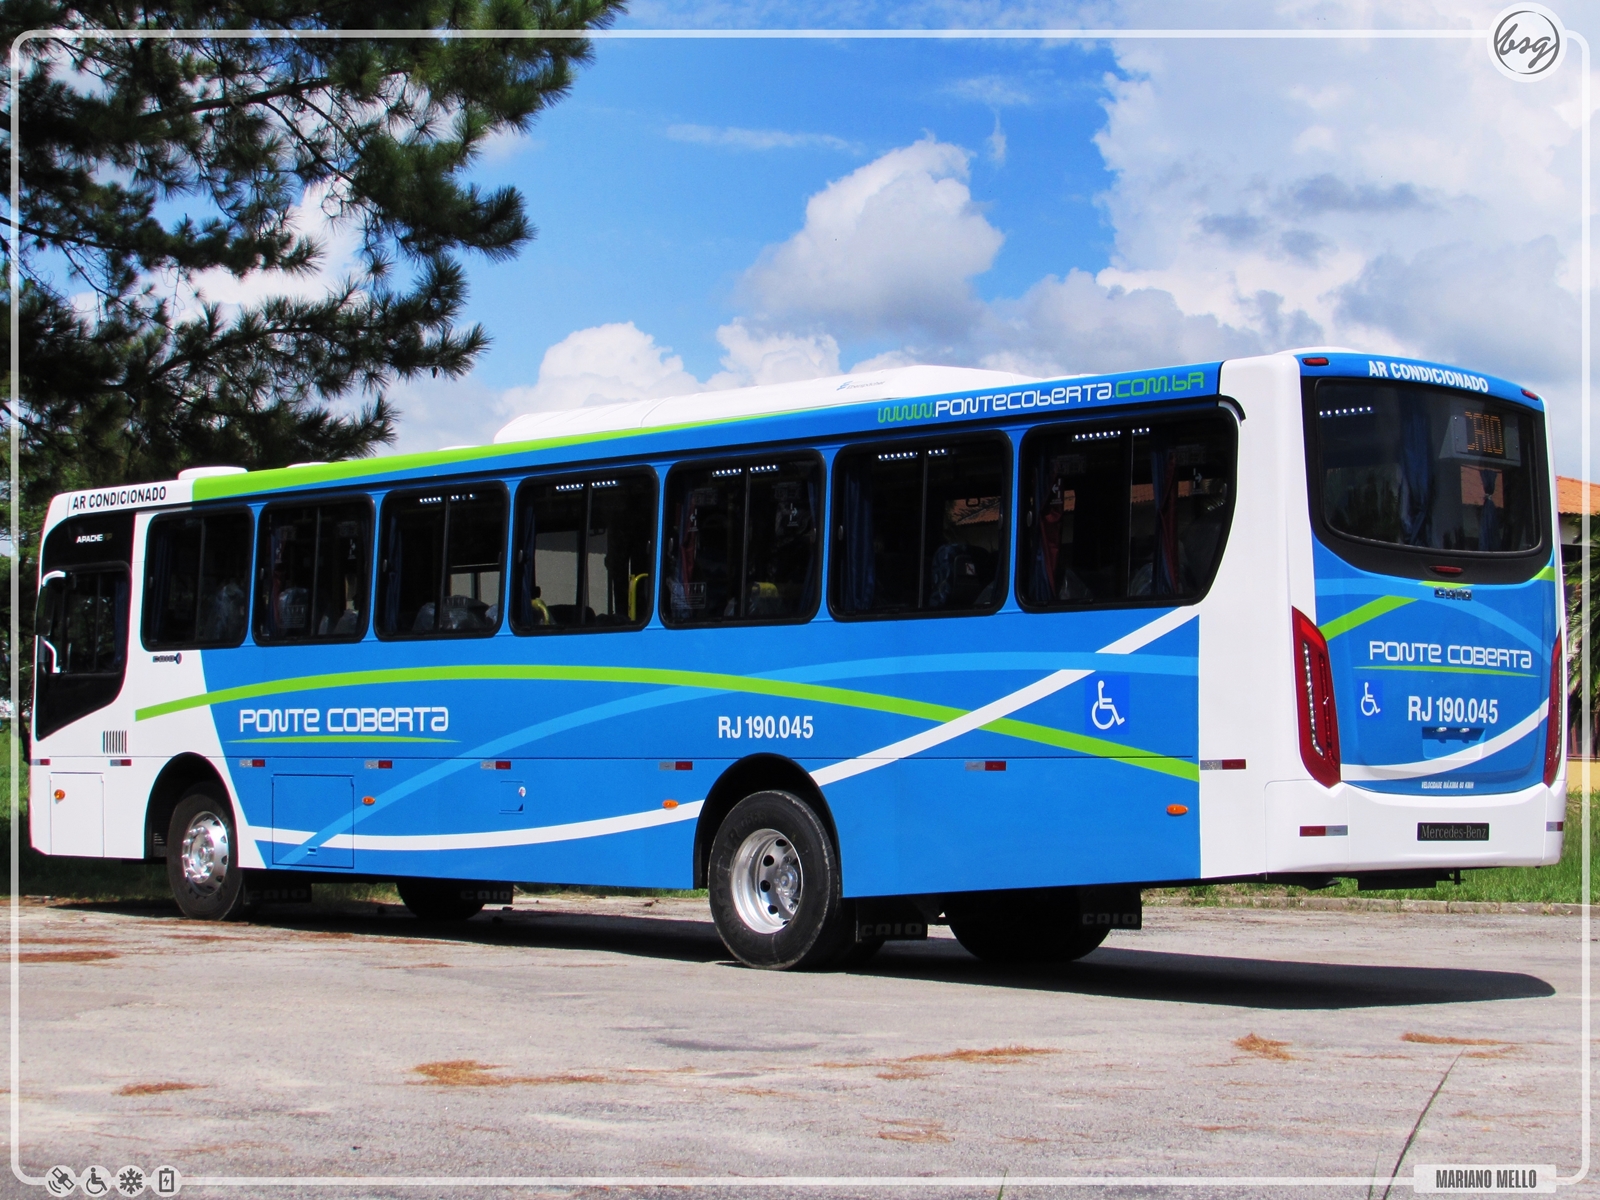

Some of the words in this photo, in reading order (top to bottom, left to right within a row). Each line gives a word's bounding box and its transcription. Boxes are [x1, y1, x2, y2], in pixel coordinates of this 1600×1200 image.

[1368, 360, 1389, 378] AR
[1391, 362, 1489, 393] CONDICIONADO
[72, 495, 86, 510] AR
[89, 486, 166, 508] CONDICIONADO
[75, 533, 103, 544] APACHE
[1408, 696, 1433, 722] RJ
[1436, 697, 1498, 724] 190.045
[718, 716, 741, 740] RJ
[745, 715, 814, 739] 190.045
[1421, 824, 1487, 839] Mercedes-Benz
[1082, 912, 1138, 925] CAIO
[860, 922, 923, 937] CAIO
